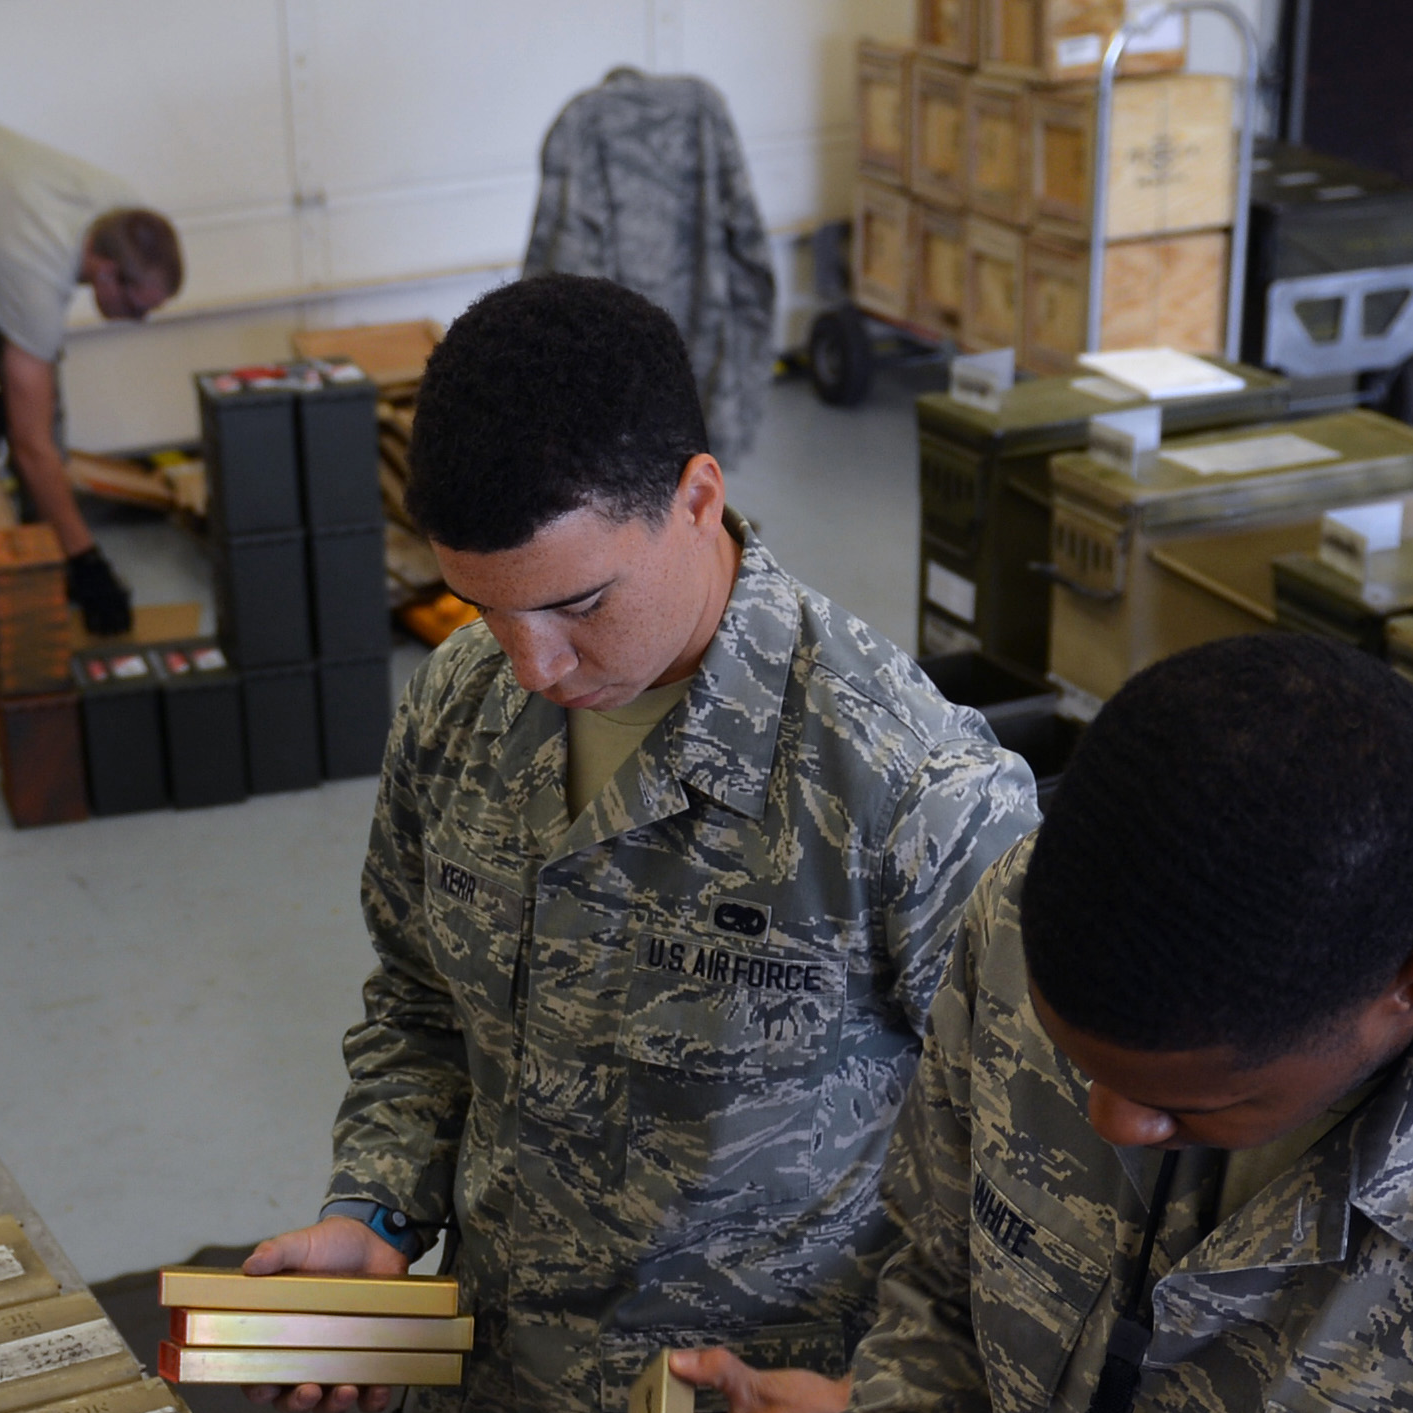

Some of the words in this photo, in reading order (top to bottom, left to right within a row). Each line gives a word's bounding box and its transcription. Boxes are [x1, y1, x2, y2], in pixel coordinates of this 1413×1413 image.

[439, 861, 477, 904] KERR
[647, 937, 688, 971] U.S.
[691, 941, 731, 980] AIR
[732, 958, 823, 992] FORCE
[972, 1176, 1038, 1260] WHITE
